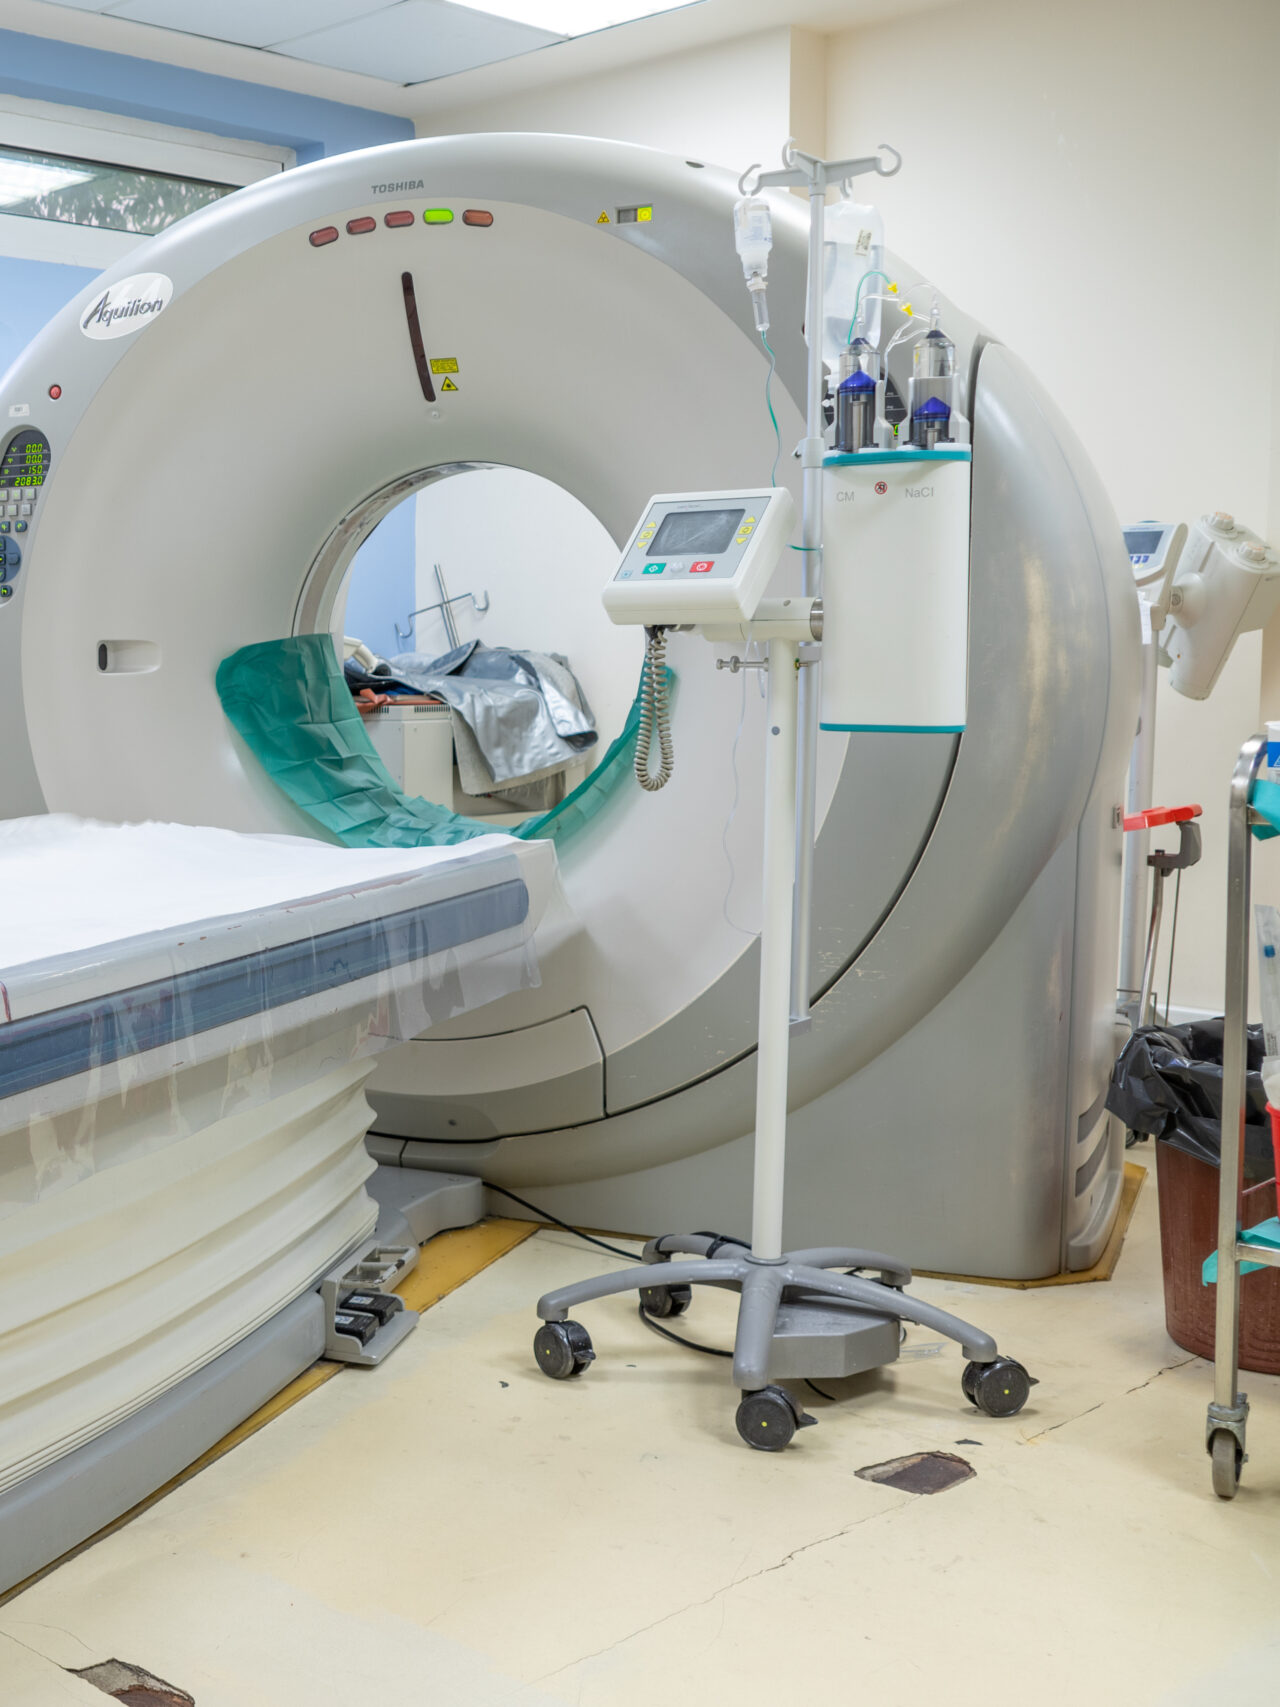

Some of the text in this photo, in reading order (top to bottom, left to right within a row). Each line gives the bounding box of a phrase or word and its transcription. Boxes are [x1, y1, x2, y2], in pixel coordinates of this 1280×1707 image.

[371, 179, 425, 194] TOSHIBA
[82, 290, 164, 330] Aquilion
[835, 487, 935, 503] CM NaCl
